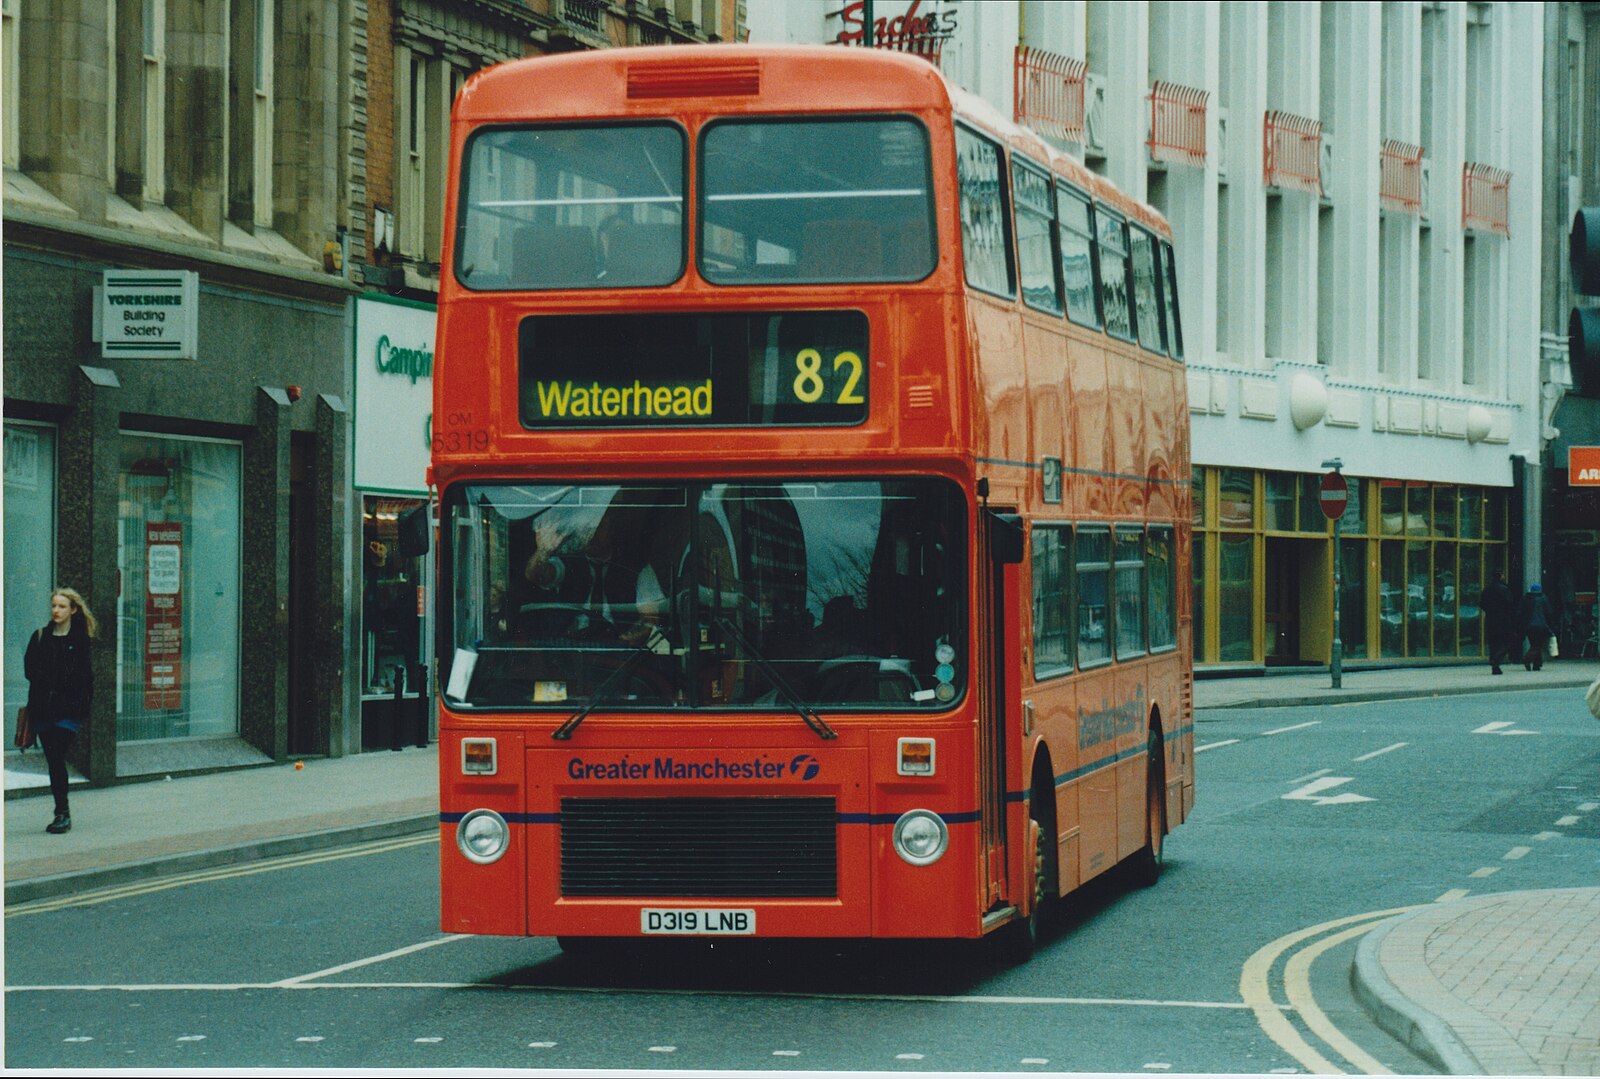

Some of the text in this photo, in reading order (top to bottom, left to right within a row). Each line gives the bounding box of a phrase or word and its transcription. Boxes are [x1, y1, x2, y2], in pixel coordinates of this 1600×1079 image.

[107, 295, 182, 305] YORKSHIRE
[124, 310, 165, 322] Building
[124, 325, 163, 337] Society
[792, 348, 865, 405] 82
[537, 379, 713, 418] Waterhead
[448, 412, 472, 426] OM
[432, 430, 489, 452] 5319
[1578, 468, 1600, 480] AR
[568, 757, 785, 779] Greater Manchester
[648, 912, 748, 931] D319 LNB
